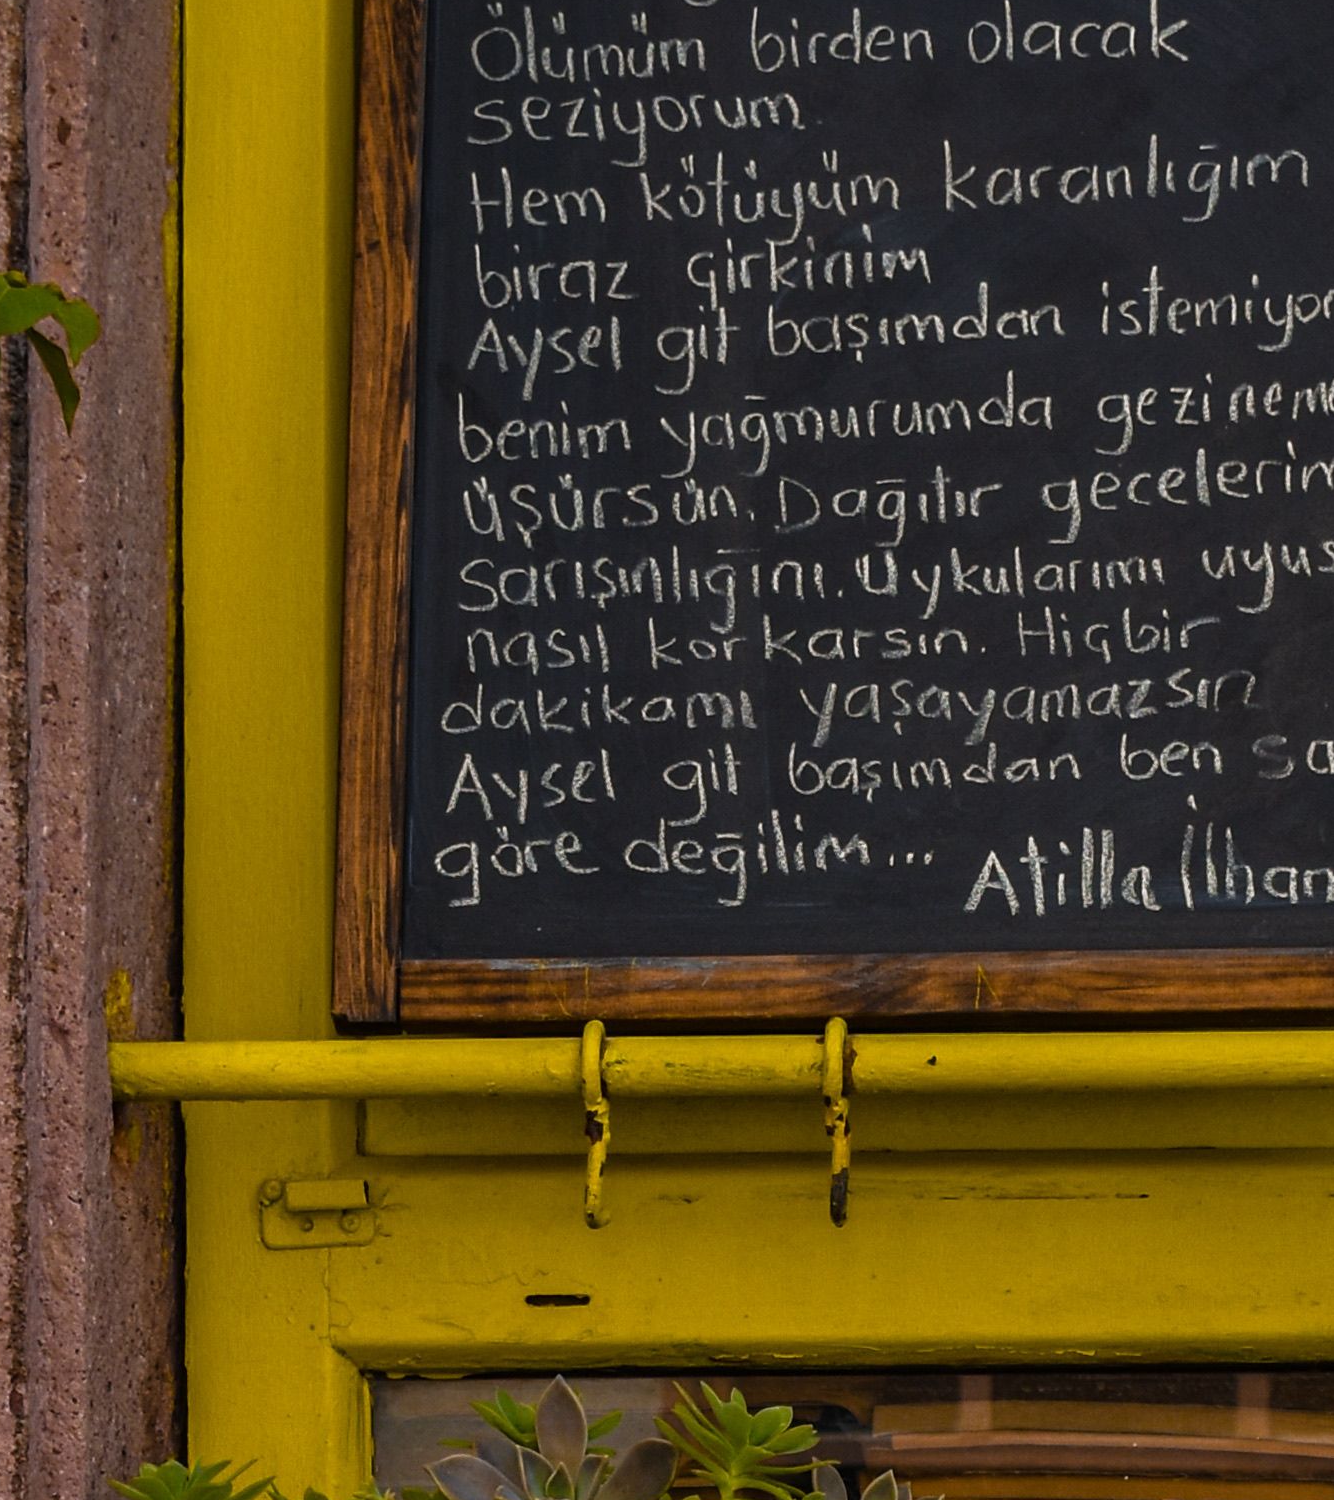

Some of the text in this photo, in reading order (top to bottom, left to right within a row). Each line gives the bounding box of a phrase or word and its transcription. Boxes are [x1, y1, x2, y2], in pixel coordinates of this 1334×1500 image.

[471, 2, 706, 83] Ölümüm
[751, 6, 933, 73] birden
[470, 134, 1310, 245] Hem kötüyüm karanlığım
[474, 243, 639, 308] biraz
[467, 315, 623, 401] Aysel
[654, 305, 741, 395] git
[768, 281, 1066, 363] başımdan
[458, 392, 631, 463] benim
[660, 369, 1053, 479] yağmurumda
[466, 623, 610, 676] nasıl
[440, 667, 1262, 748] dakikamı yaşayamazsın
[445, 748, 616, 824] Aysel
[662, 742, 741, 827] git
[788, 741, 1082, 804] başımdan
[1121, 733, 1223, 780] ben
[434, 825, 600, 907] göre
[964, 826, 1162, 917] Atilla
